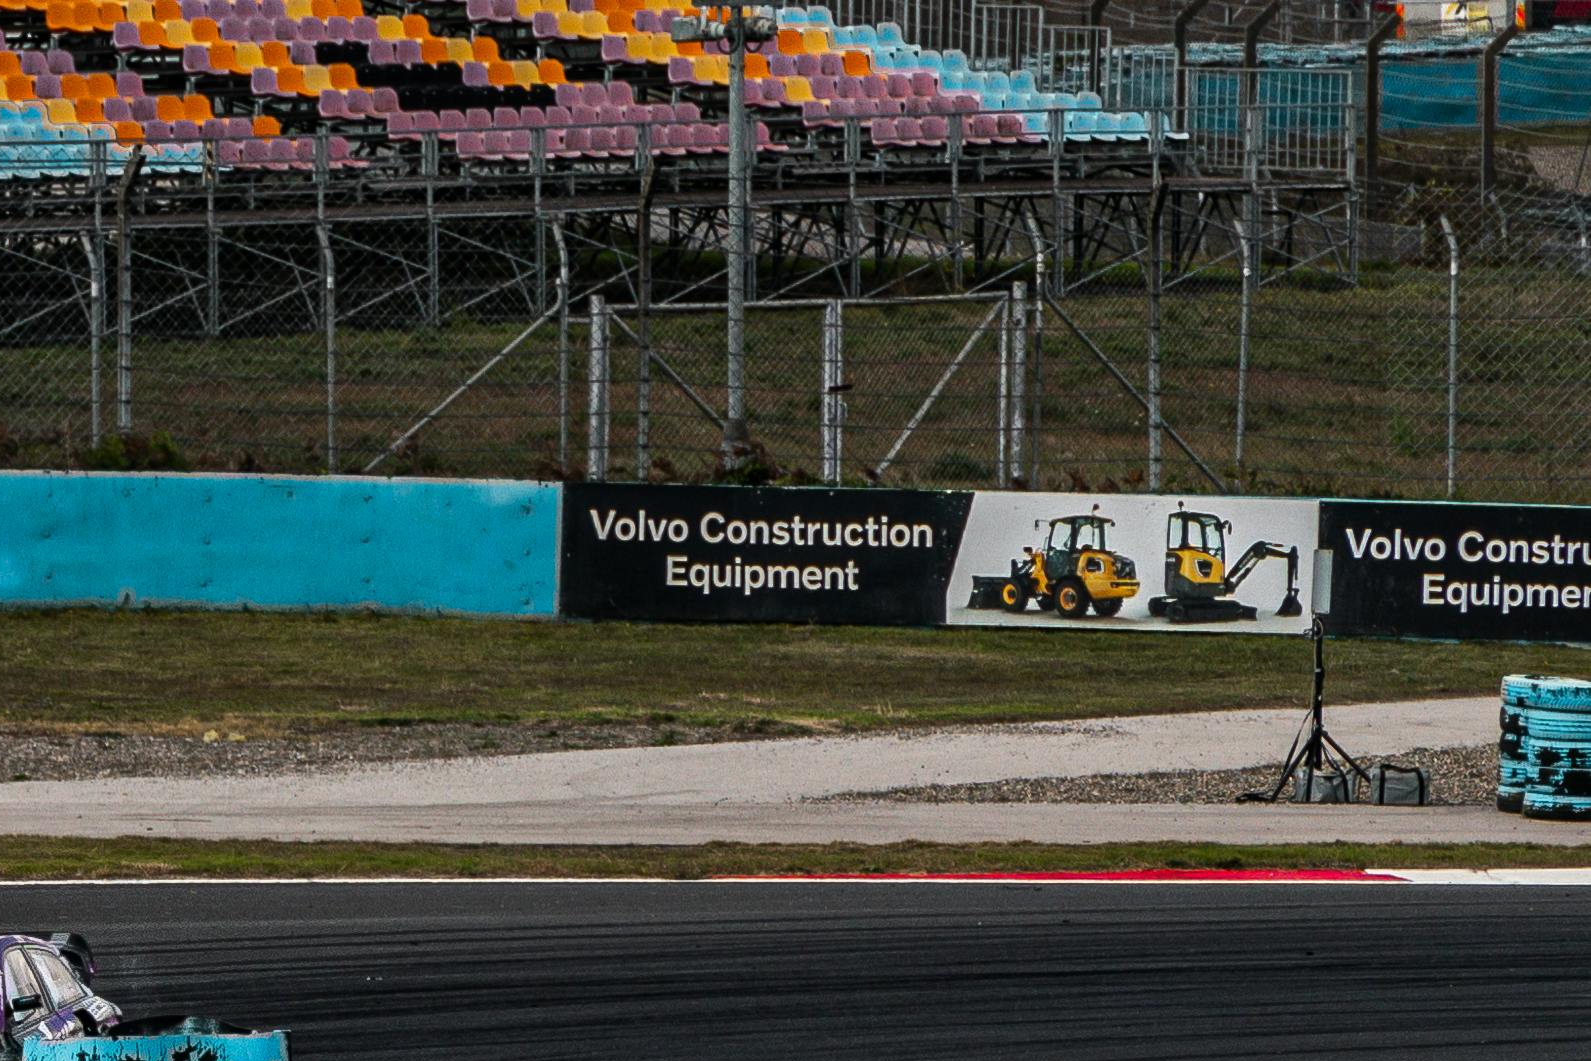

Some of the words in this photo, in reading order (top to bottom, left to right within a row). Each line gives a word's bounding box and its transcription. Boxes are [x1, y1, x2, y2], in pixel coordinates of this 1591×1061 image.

[589, 509, 689, 542] Volvo
[700, 511, 934, 548] Construction
[1345, 528, 1447, 561] Volvo
[665, 555, 859, 595] Equipment
